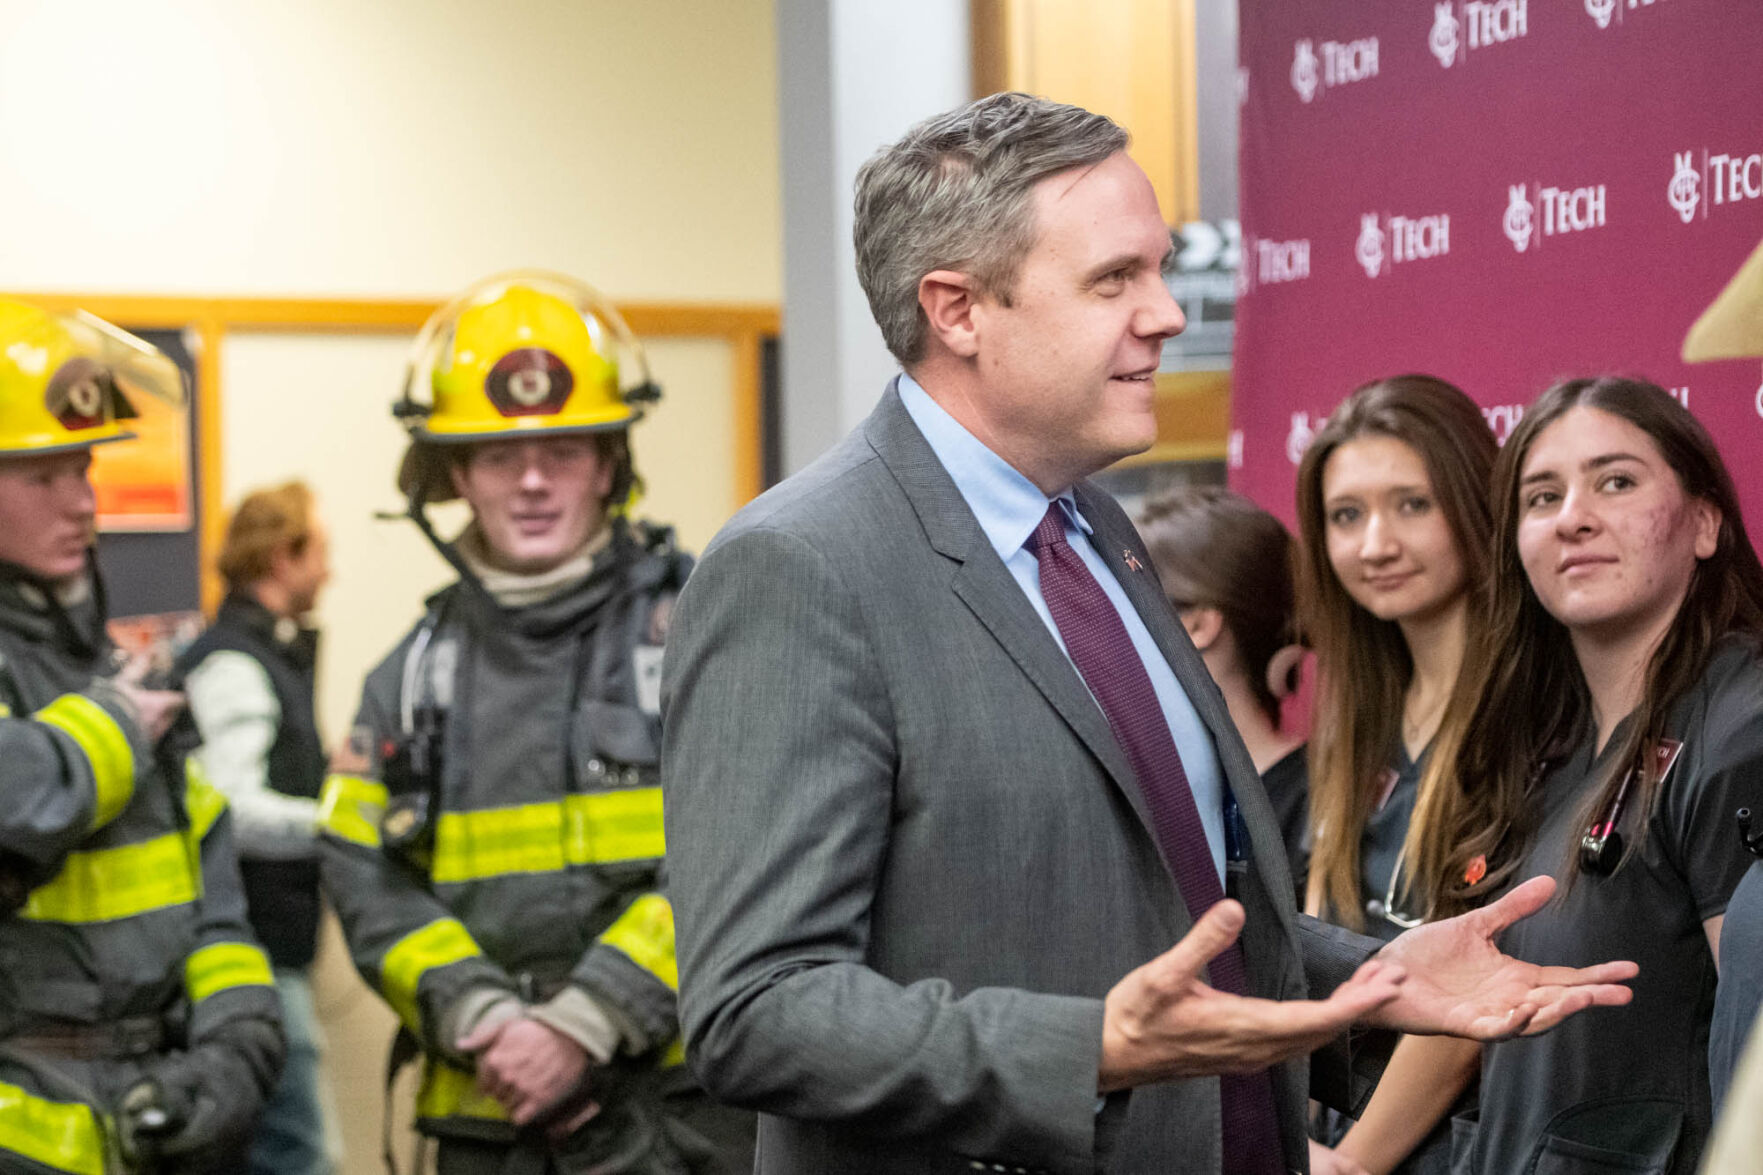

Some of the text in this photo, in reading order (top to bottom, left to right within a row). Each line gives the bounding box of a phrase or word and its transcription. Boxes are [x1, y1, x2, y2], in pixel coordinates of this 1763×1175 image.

[1465, 0, 1528, 49] TECH
[1322, 37, 1378, 87] TECH
[1709, 154, 1763, 204] TEC
[1540, 184, 1606, 235] TECH
[1258, 238, 1310, 283] TECH
[1390, 213, 1449, 263] TECH
